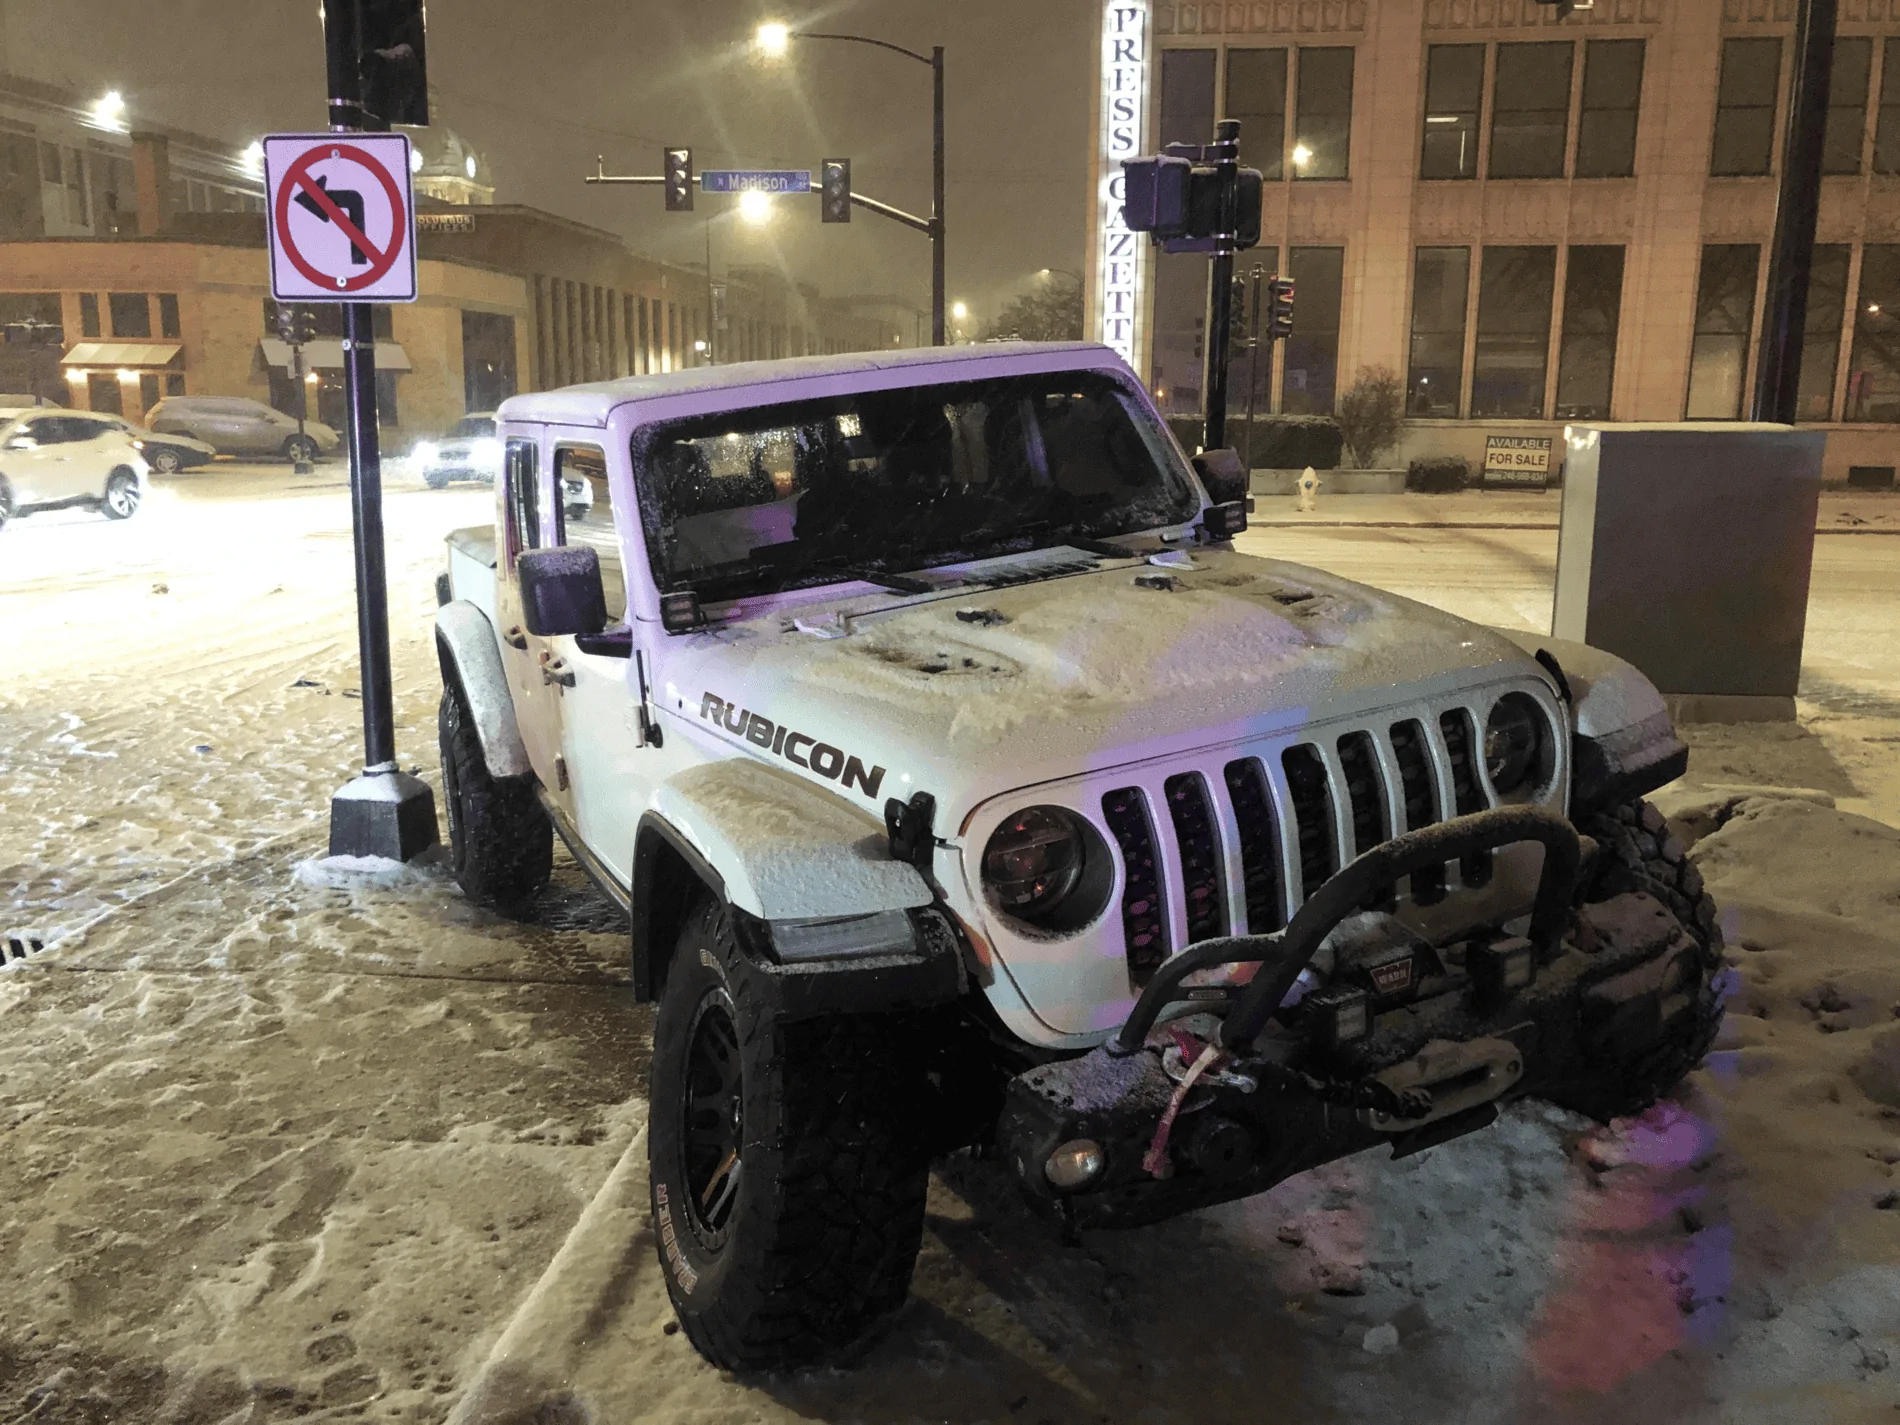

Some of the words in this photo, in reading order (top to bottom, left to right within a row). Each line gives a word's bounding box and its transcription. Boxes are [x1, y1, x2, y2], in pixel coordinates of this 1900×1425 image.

[1112, 8, 1141, 151] PRESS
[728, 173, 788, 190] Madison
[416, 214, 471, 224] OLUMBUS
[1487, 438, 1551, 450] AVAILABLE
[1489, 453, 1513, 465] FOR
[1515, 454, 1546, 466] SALE
[699, 691, 887, 800] RUBICON
[1379, 968, 1408, 985] WARN
[656, 1183, 698, 1295] GRABBER
